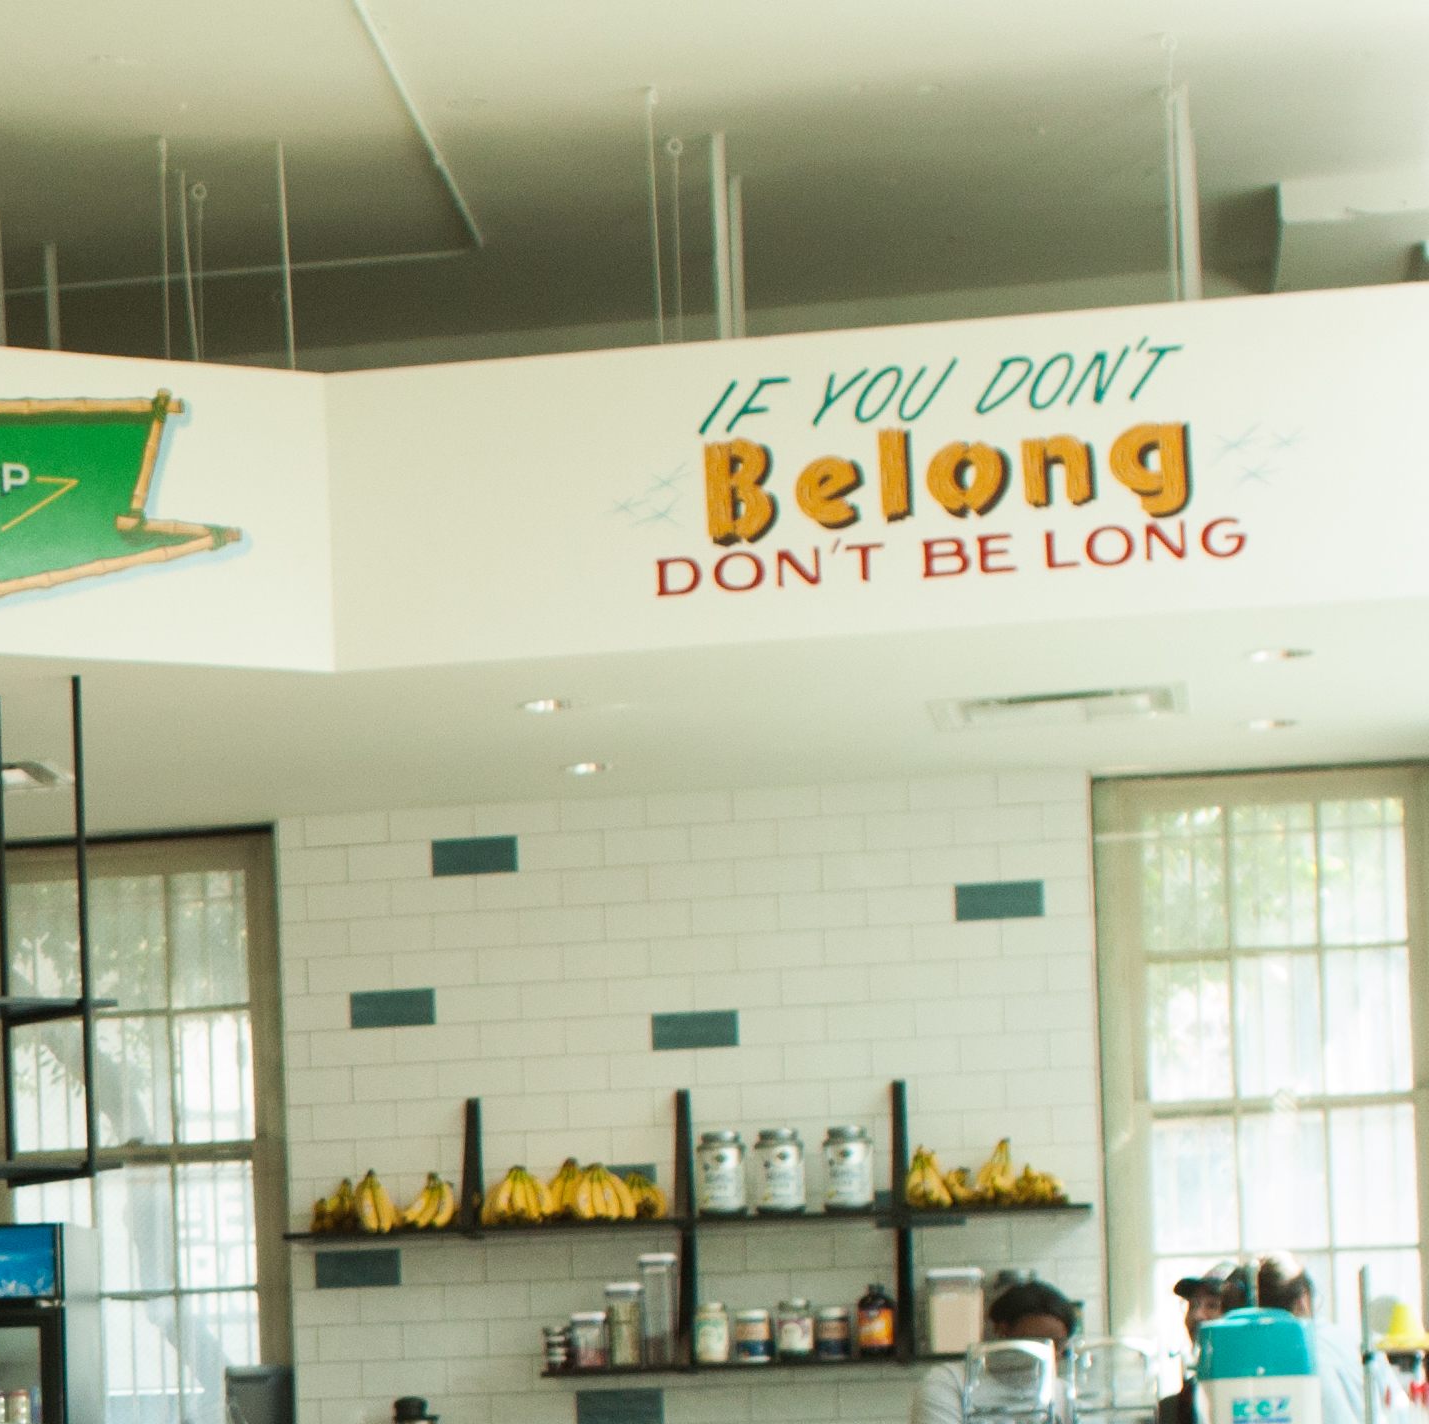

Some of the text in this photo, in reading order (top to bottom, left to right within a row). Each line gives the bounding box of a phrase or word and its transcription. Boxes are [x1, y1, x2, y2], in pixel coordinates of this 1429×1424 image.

[699, 335, 1183, 434] IF YOU DON'T
[703, 421, 1191, 545] Belong
[655, 517, 1248, 597] DON'T BE LONG
